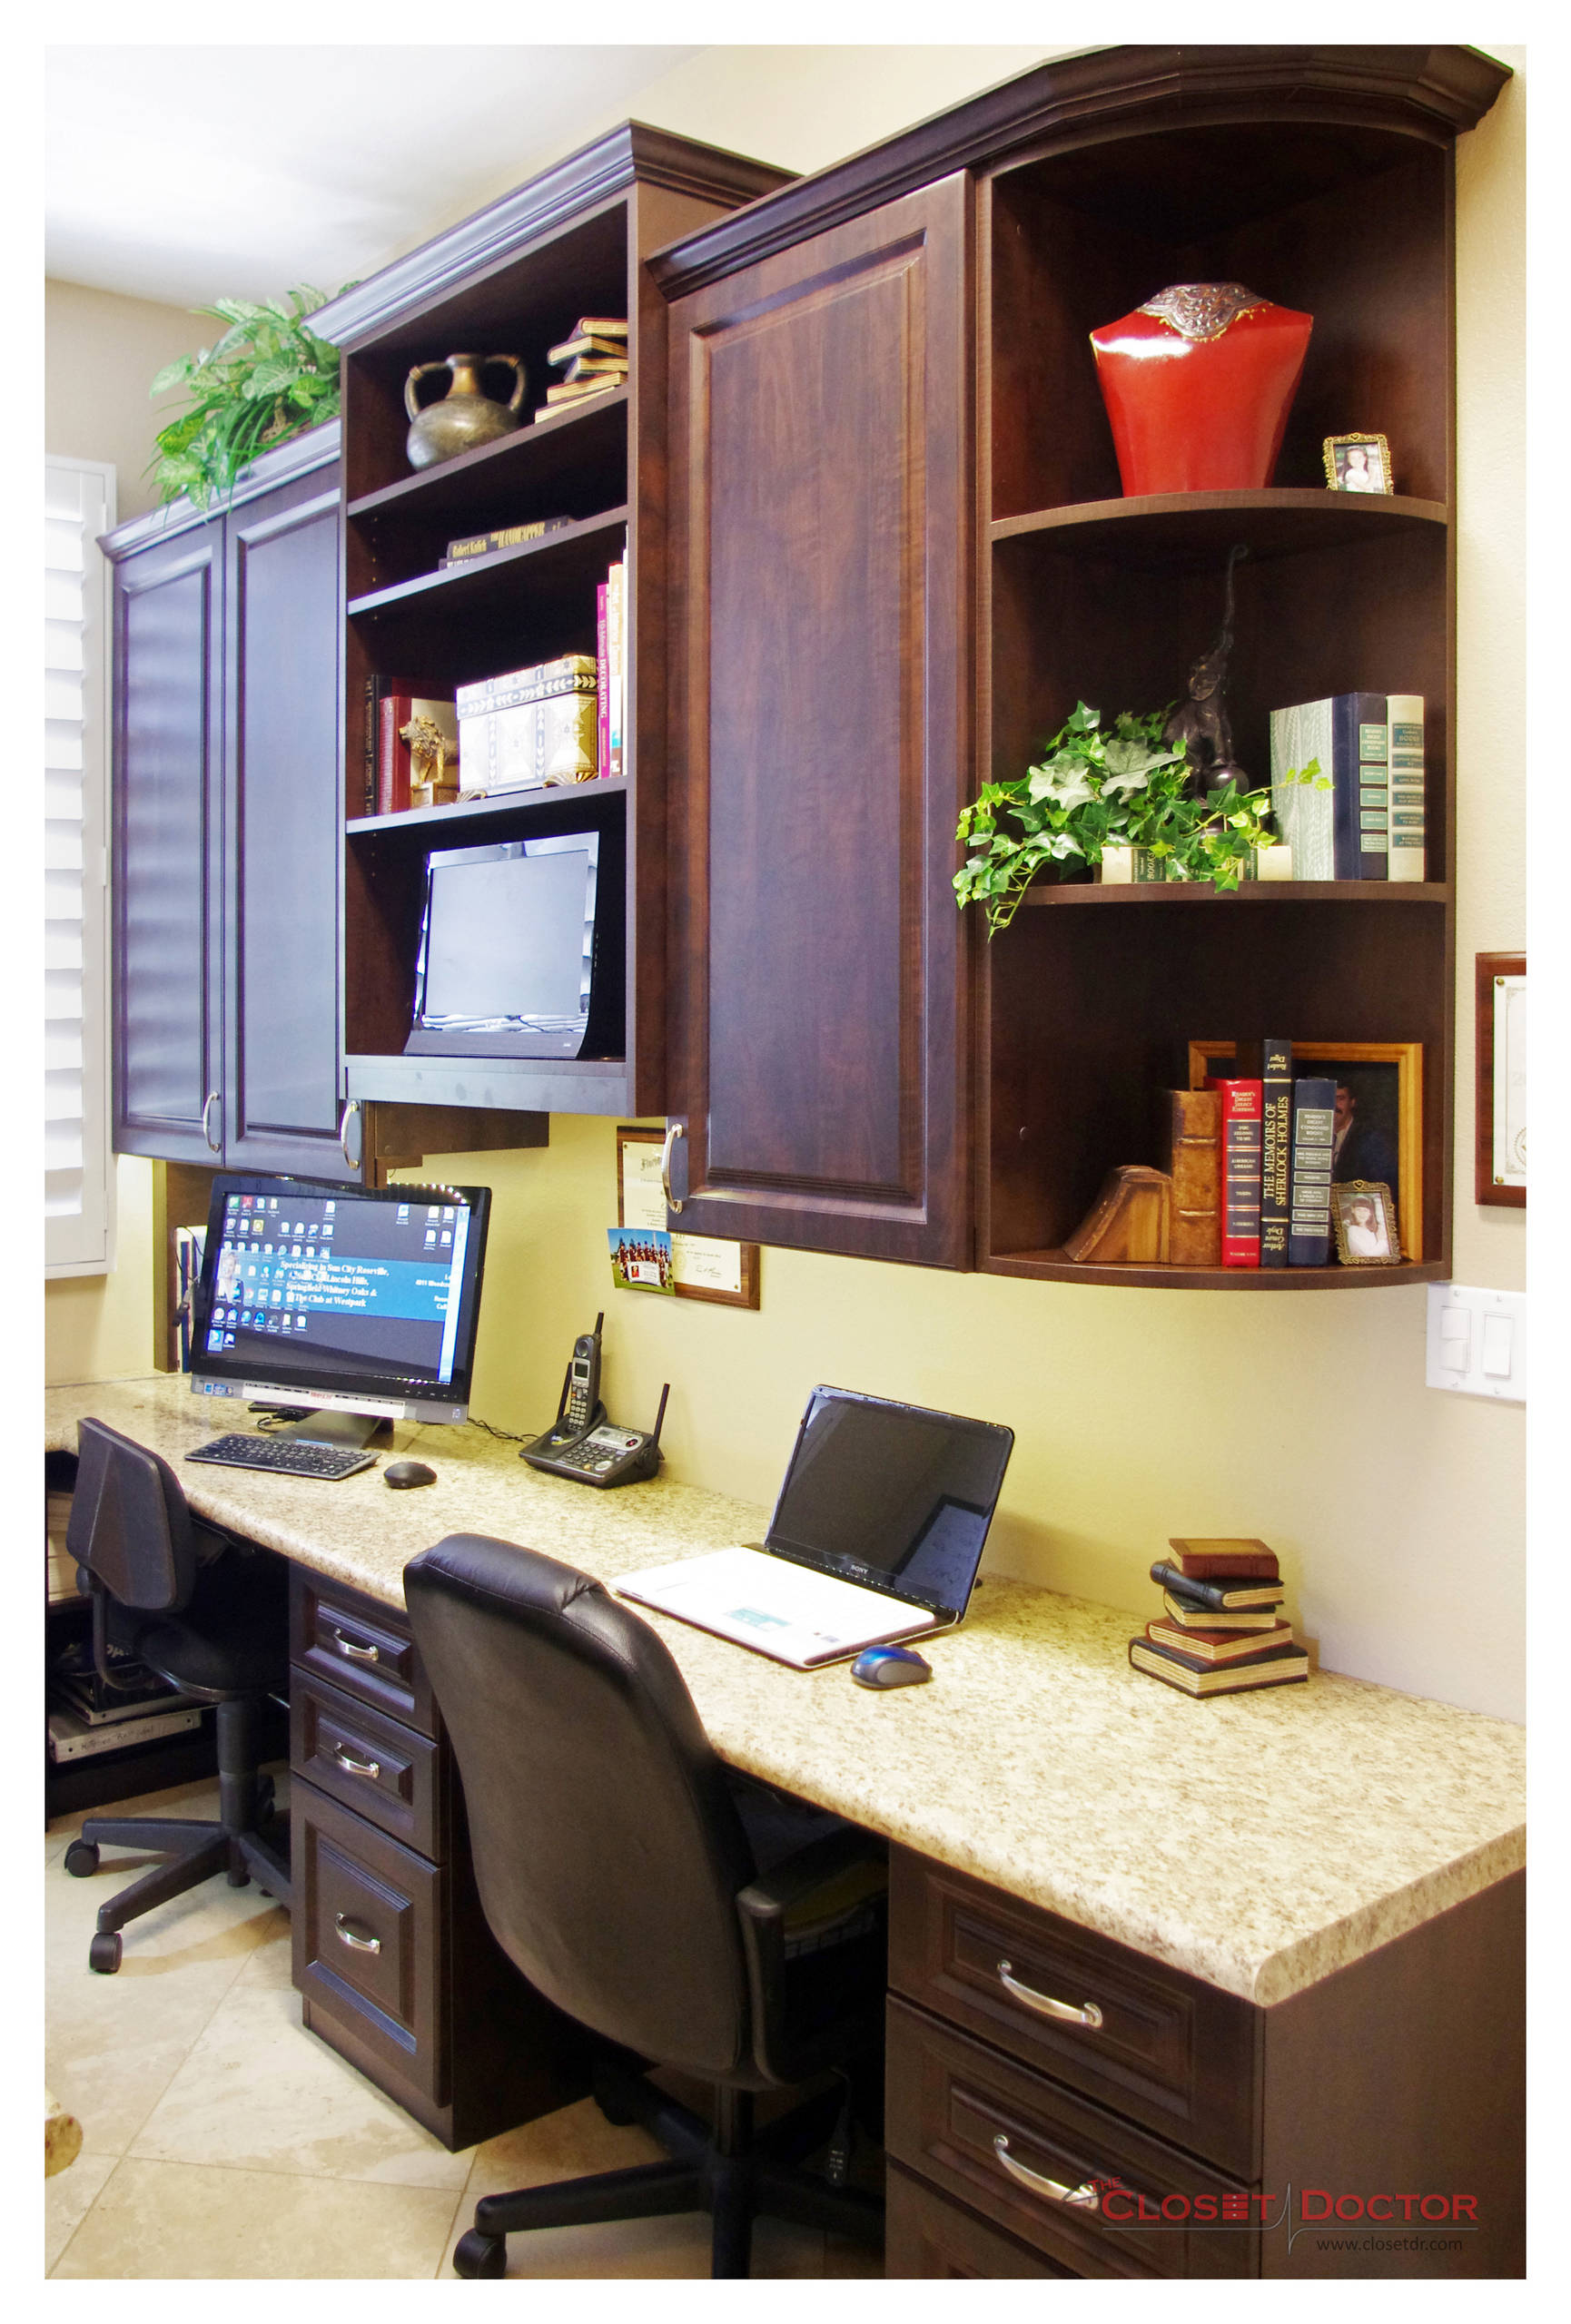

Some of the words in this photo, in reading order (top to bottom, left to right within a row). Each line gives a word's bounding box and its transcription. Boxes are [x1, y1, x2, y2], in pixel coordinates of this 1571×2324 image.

[599, 658, 608, 718] DECORATING
[1265, 1102, 1277, 1118] OF
[1277, 1097, 1289, 1143] HOLMES
[1264, 1120, 1276, 1173] MEMOIRS
[1276, 1147, 1288, 1206] SHERLOCK
[1263, 1176, 1275, 1198] THE
[281, 1261, 318, 1272] Specializing
[327, 1265, 341, 1273] Sun
[341, 1265, 356, 1275] City
[351, 1287, 370, 1296] Oaks
[309, 1295, 324, 1304] Club
[334, 1296, 367, 1308] Westpark
[850, 1564, 869, 1575] SONY
